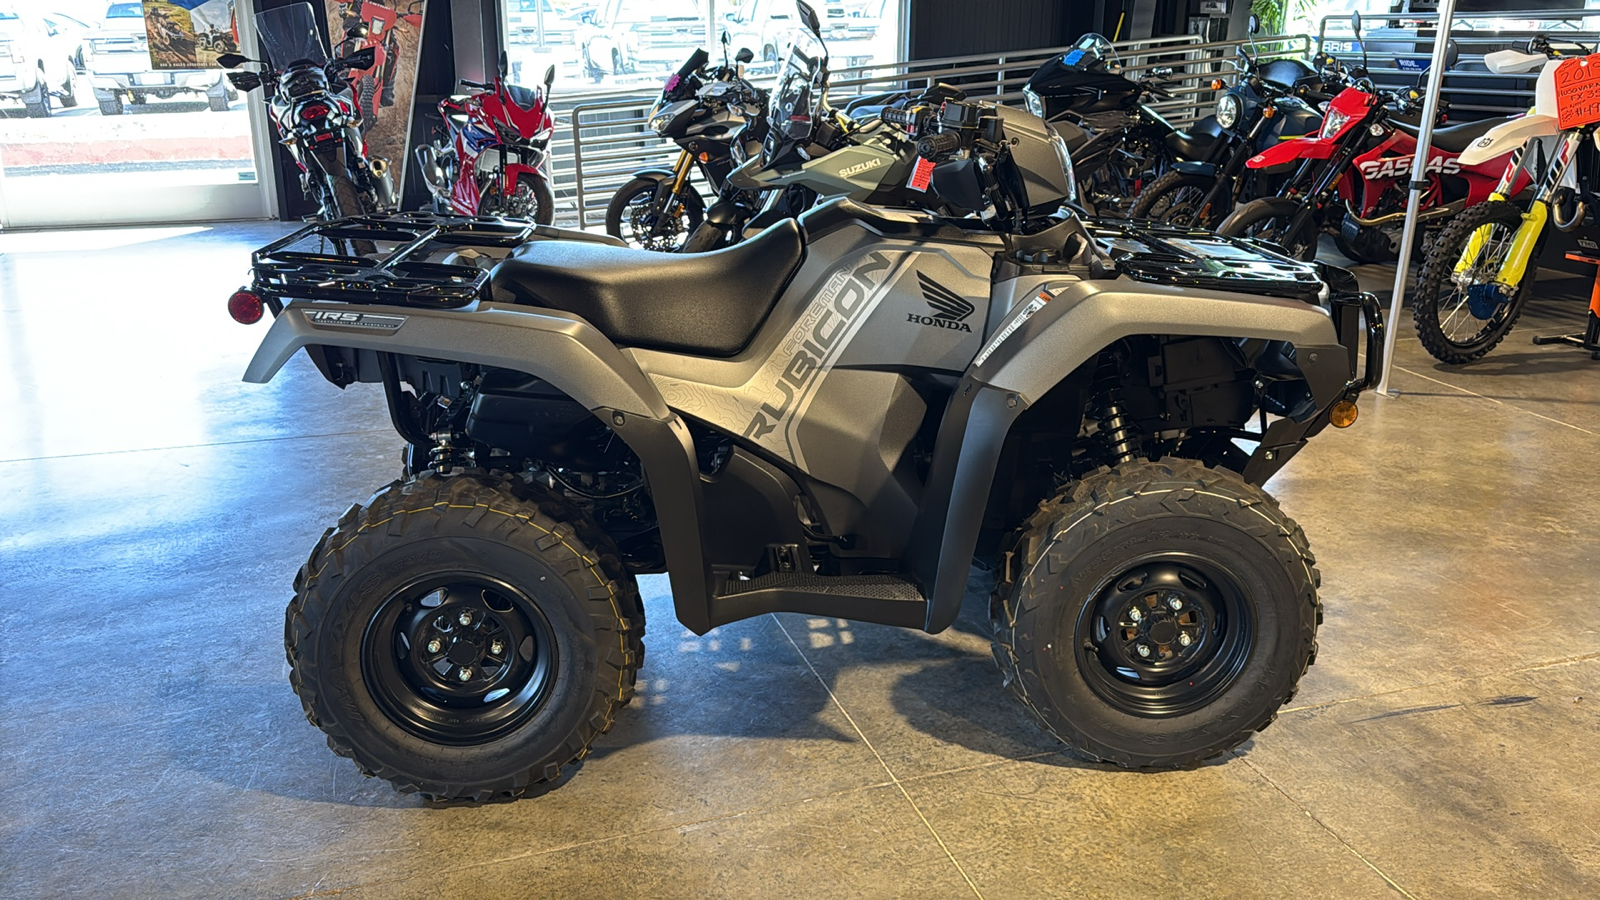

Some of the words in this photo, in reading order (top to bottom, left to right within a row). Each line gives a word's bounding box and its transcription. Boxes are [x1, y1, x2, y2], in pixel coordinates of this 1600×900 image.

[1322, 41, 1352, 52] ARIS
[838, 157, 881, 177] SUZUKI
[1359, 155, 1462, 180] GASAS
[315, 311, 359, 322] IRS
[783, 264, 852, 357] FOREMAN
[906, 312, 973, 333] HONDA
[741, 251, 891, 439] RUBICON
